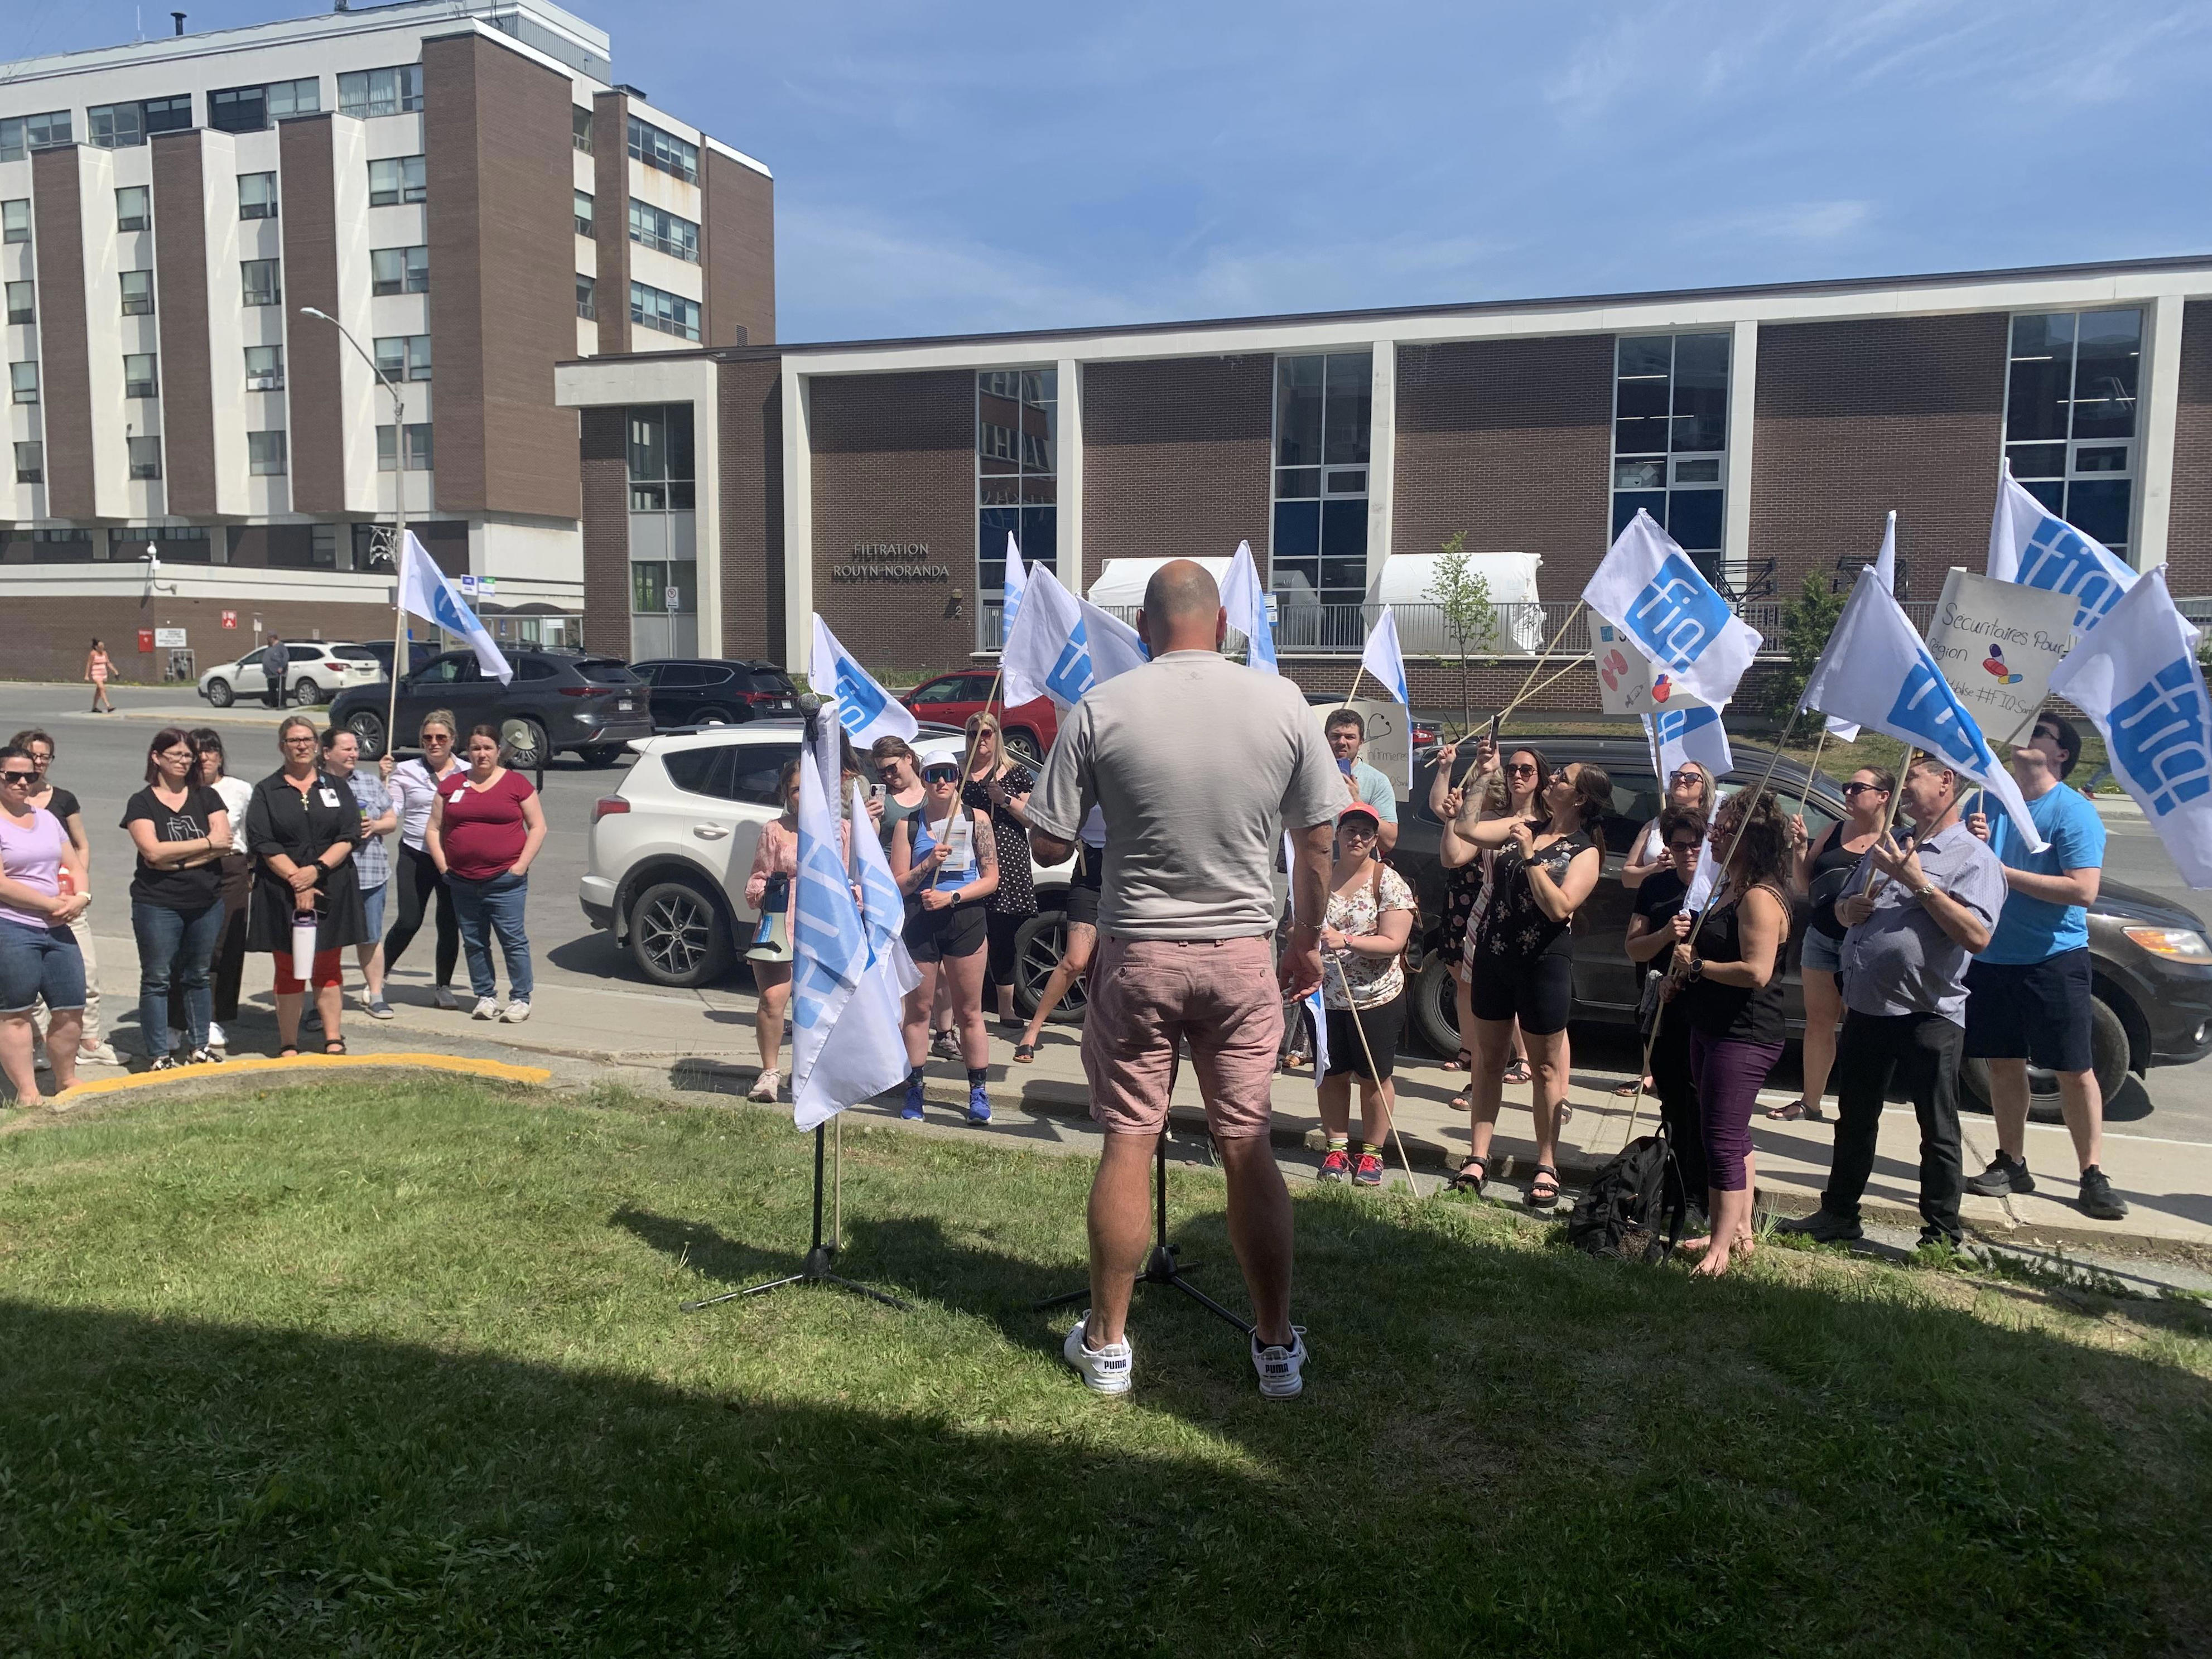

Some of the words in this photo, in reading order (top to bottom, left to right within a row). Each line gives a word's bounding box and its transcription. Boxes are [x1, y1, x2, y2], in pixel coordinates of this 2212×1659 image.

[854, 543, 928, 556] FILTRATION
[1104, 1359, 1126, 1369] PUMA
[1265, 1363, 1289, 1374] PUMA
